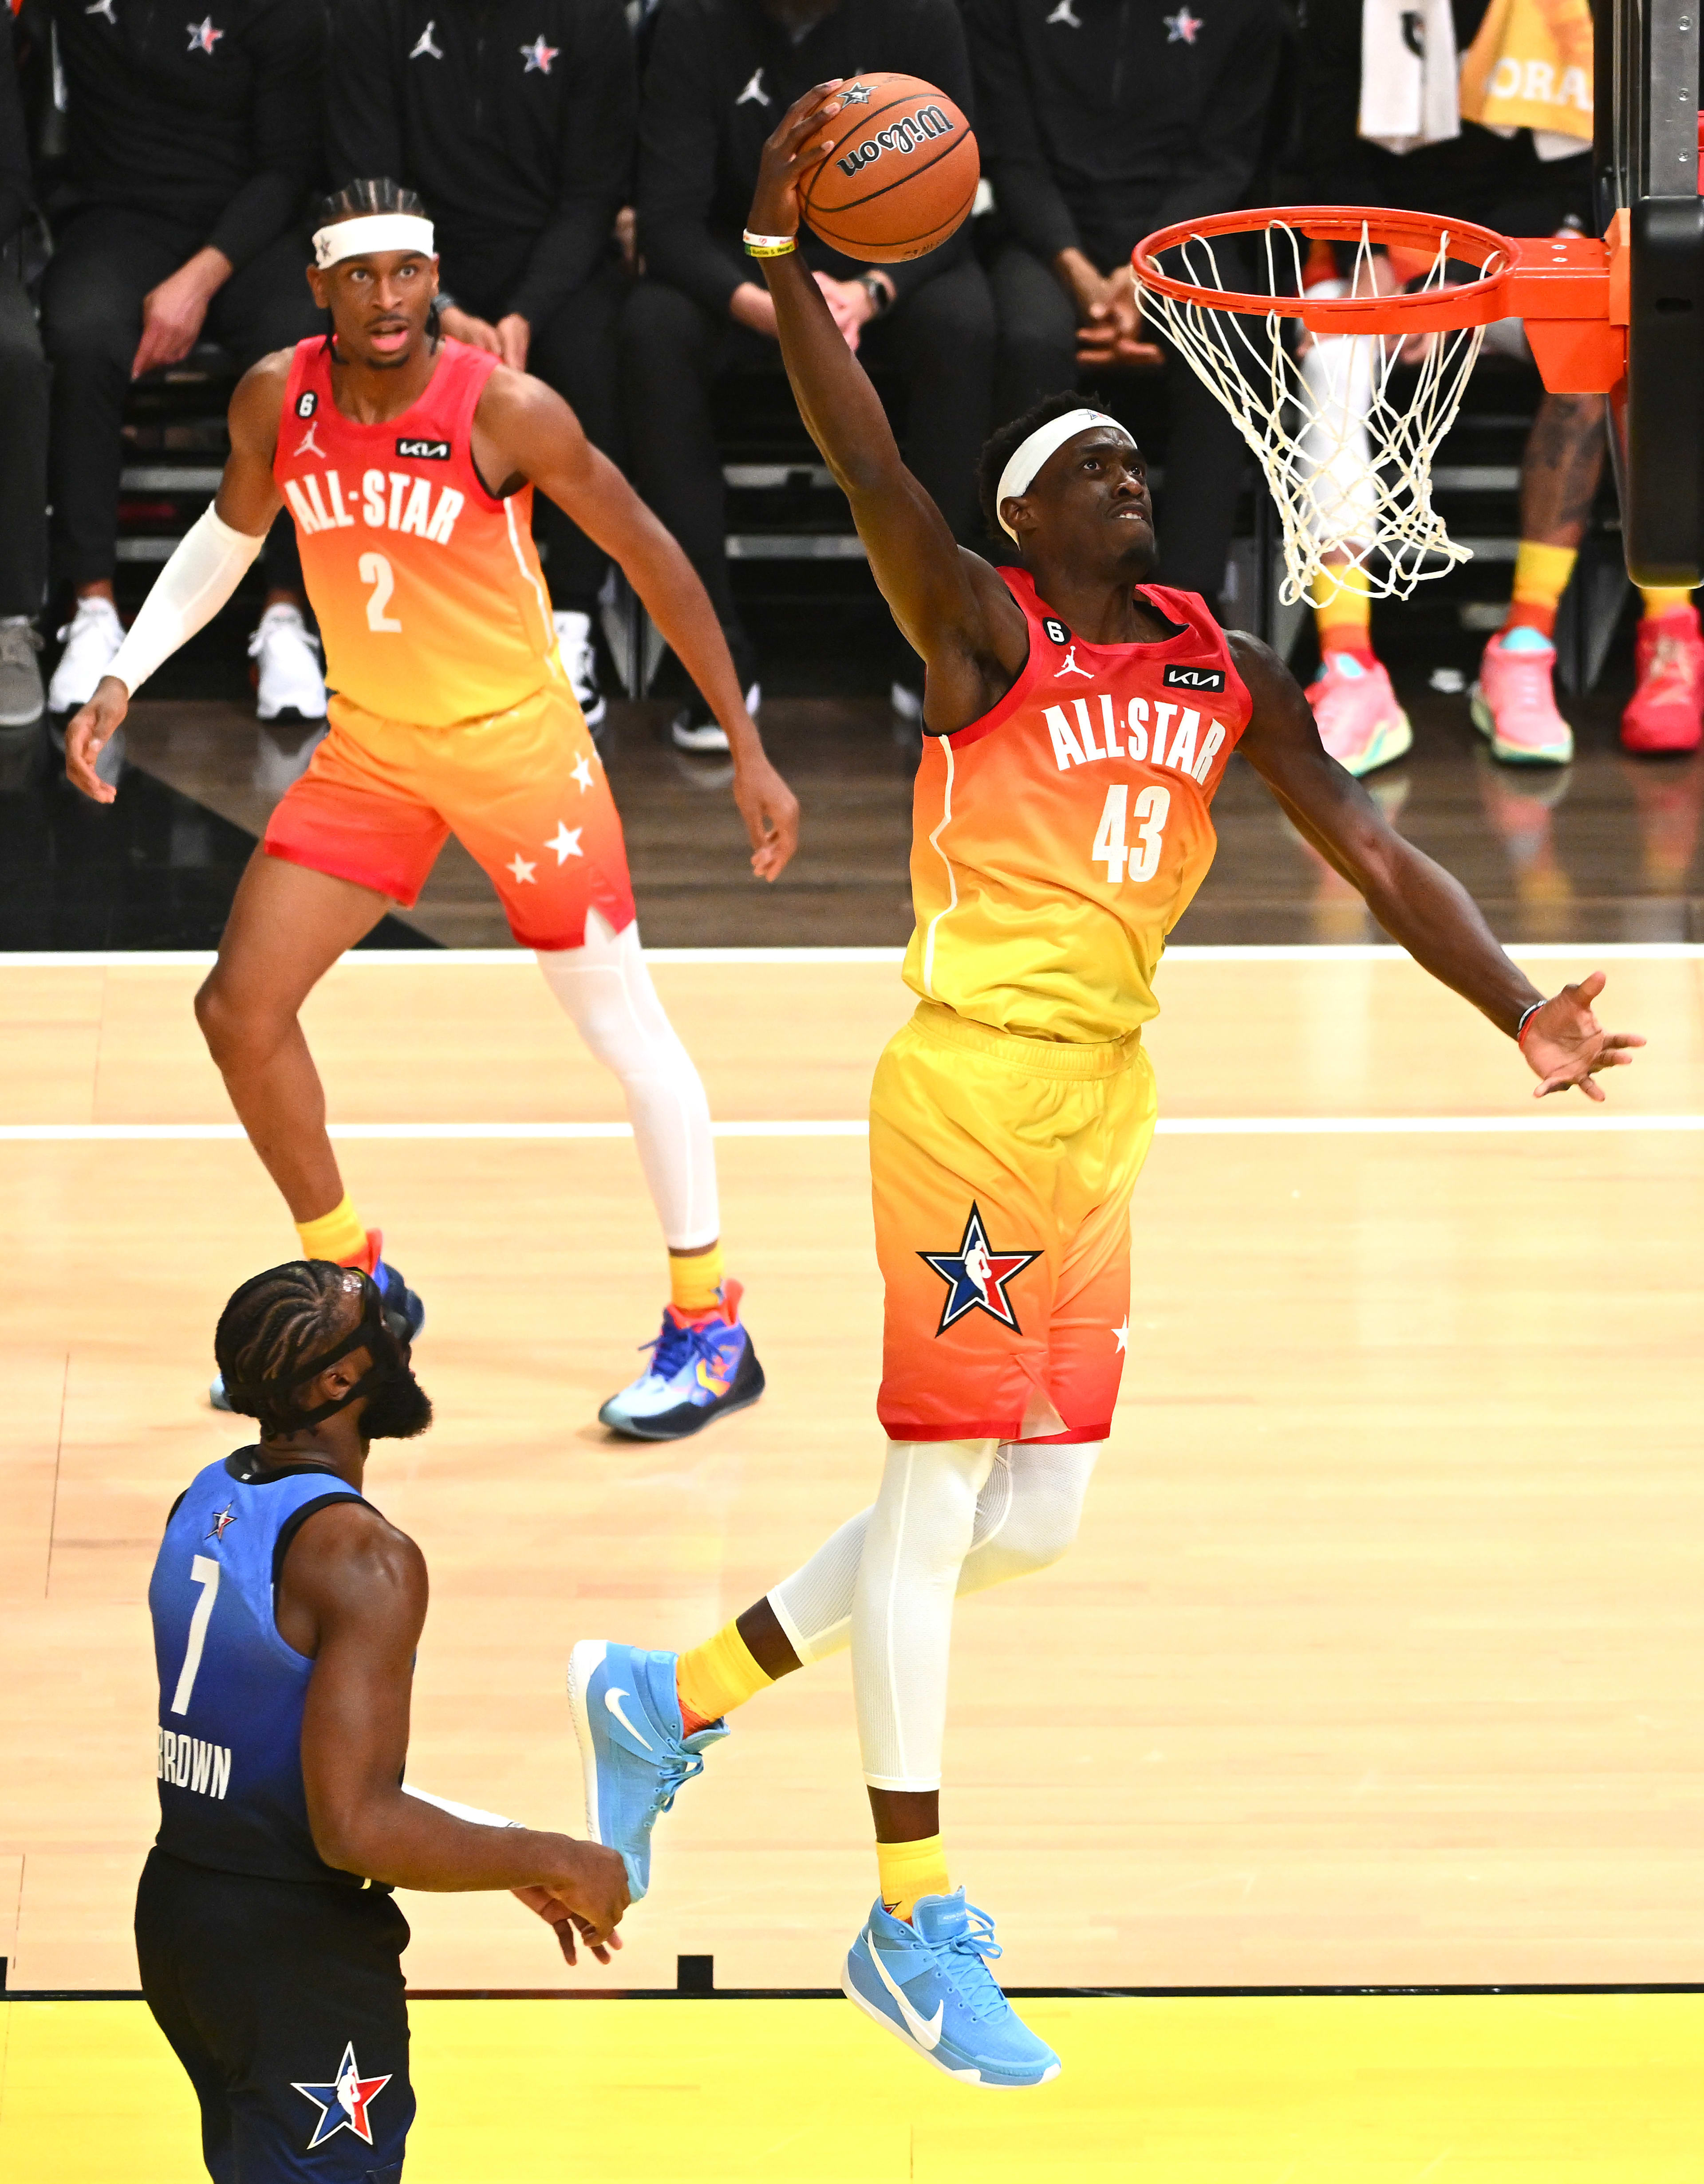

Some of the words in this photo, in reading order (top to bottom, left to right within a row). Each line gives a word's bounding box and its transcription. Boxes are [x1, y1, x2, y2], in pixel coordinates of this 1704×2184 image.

[836, 105, 954, 177] Wilson
[299, 394, 314, 417] 6
[400, 441, 448, 458] KIA
[359, 552, 402, 633] 2
[1047, 621, 1065, 642] 6
[1168, 670, 1219, 688] KIA
[1092, 784, 1171, 883] 43
[170, 1554, 219, 1716] 7
